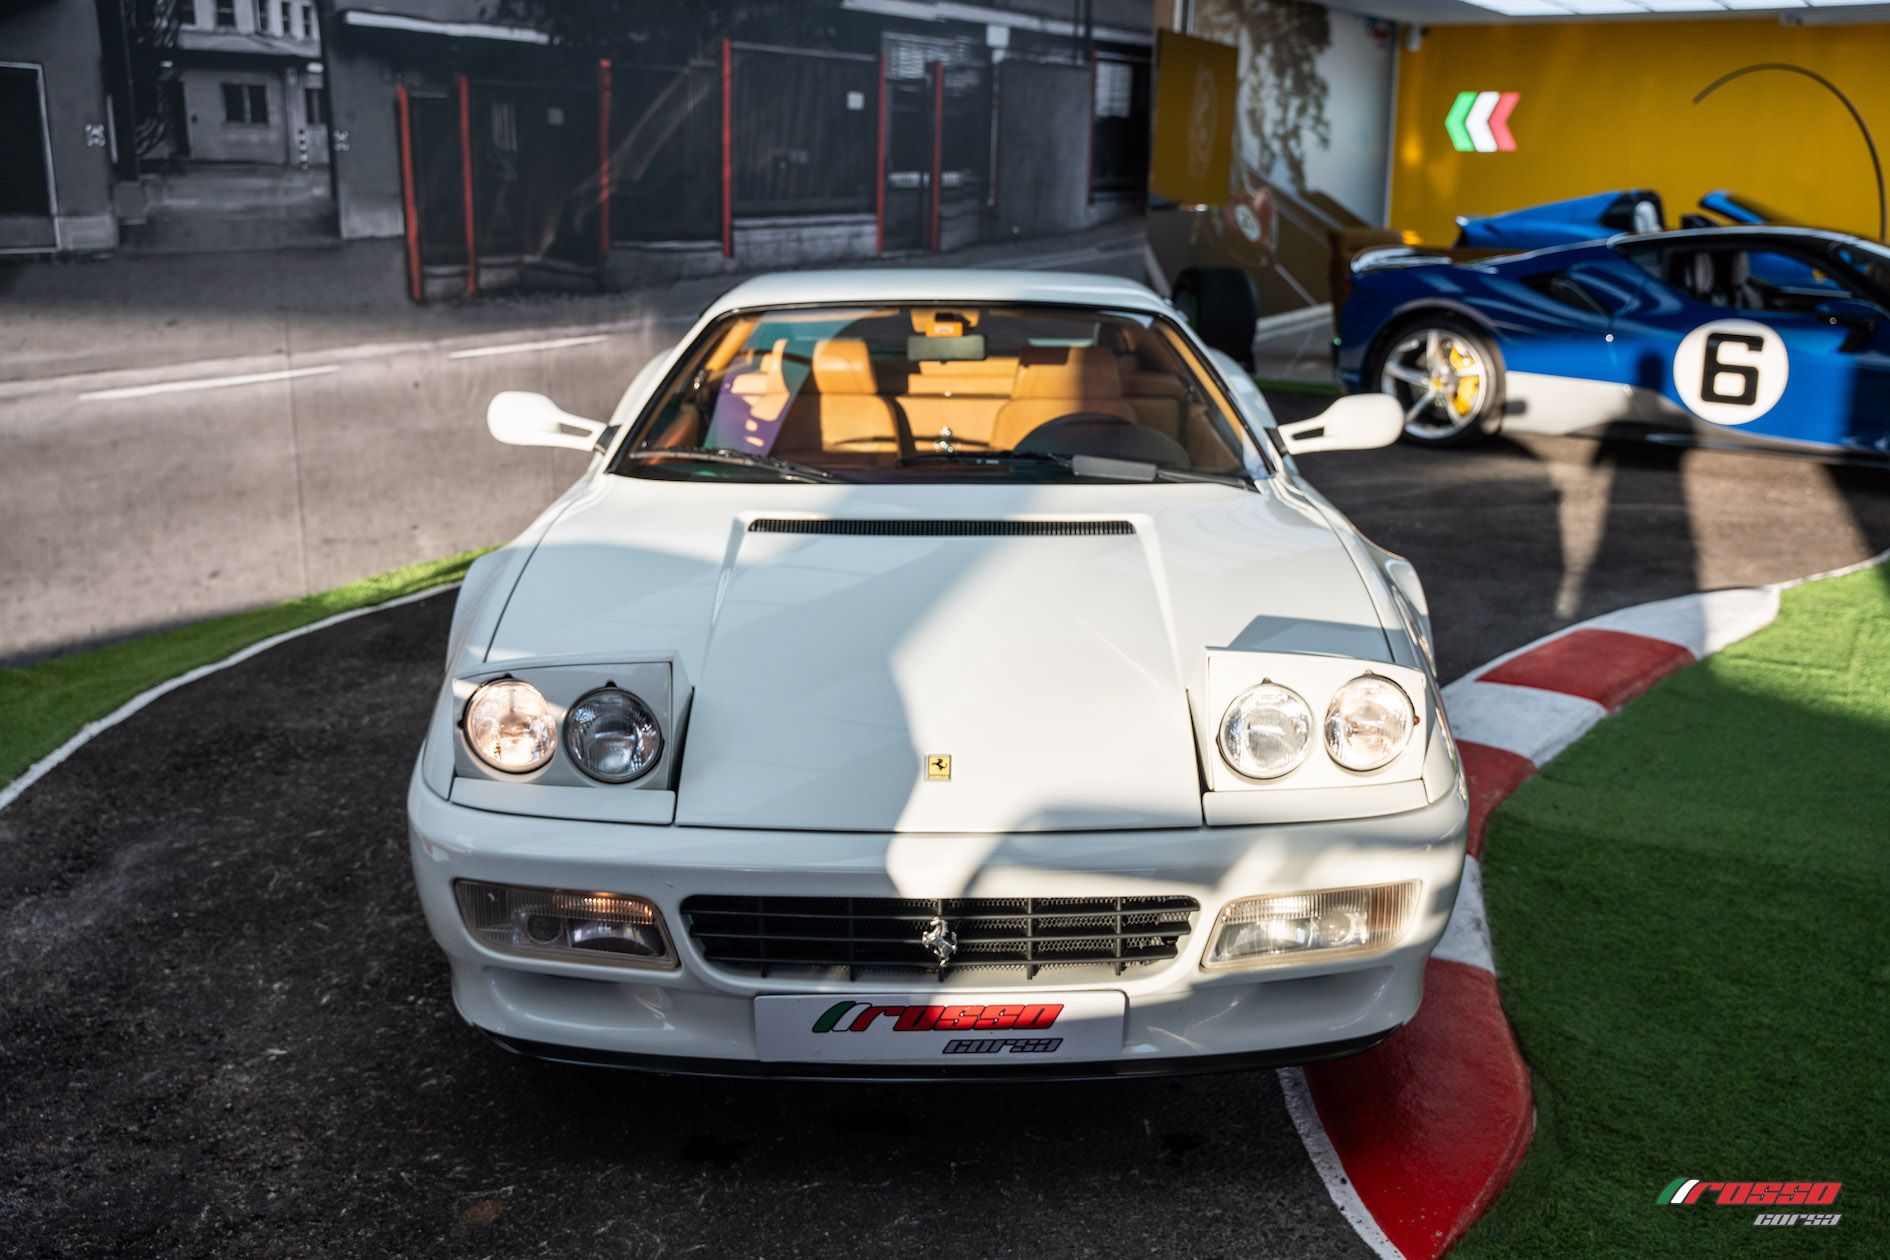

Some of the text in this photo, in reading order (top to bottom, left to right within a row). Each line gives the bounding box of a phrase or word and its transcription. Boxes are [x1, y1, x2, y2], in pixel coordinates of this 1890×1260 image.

[1700, 332, 1764, 406] 6
[849, 1003, 1064, 1031] rosso
[942, 1037, 1063, 1054] corsa
